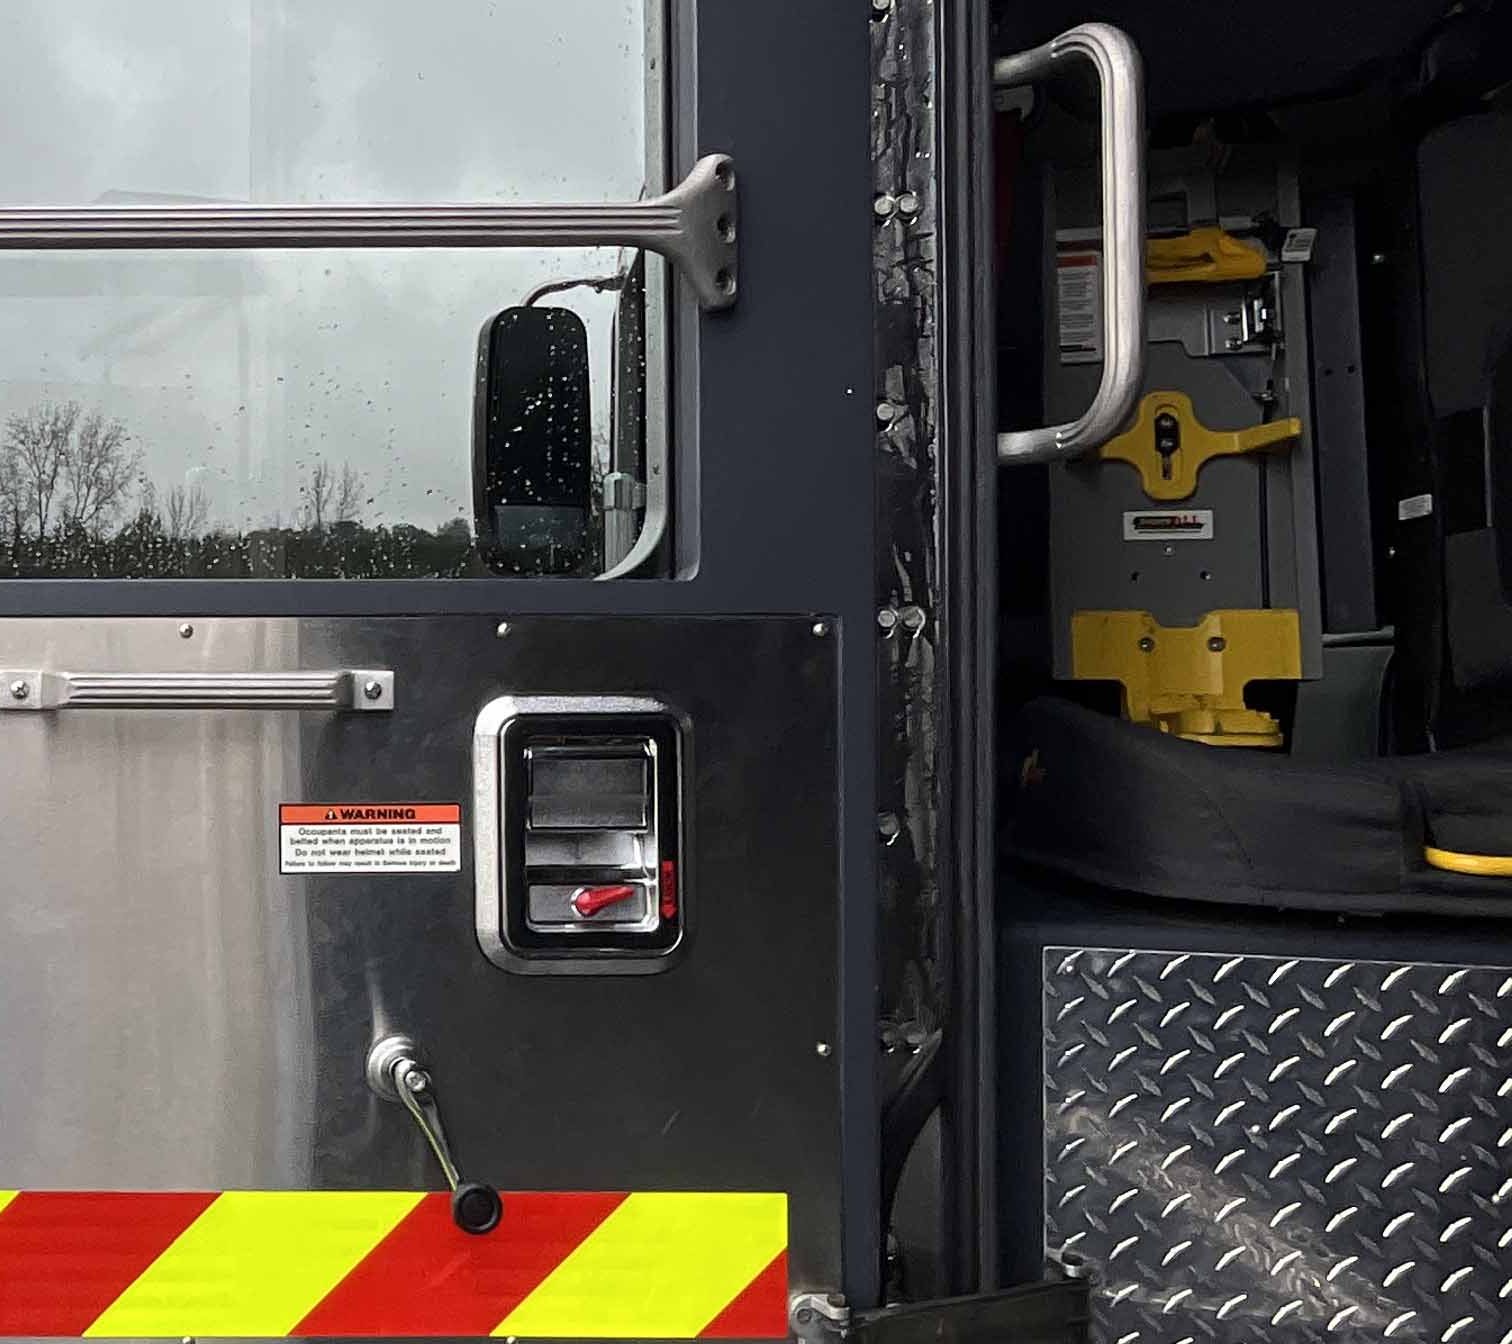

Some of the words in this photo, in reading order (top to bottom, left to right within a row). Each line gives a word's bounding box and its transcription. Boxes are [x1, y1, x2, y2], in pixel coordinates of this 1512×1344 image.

[341, 809, 416, 819] WARNING
[299, 828, 346, 836] Occupants
[426, 827, 442, 835] and
[290, 837, 318, 845] belted
[322, 837, 345, 845] when
[349, 838, 394, 846] apparatus
[355, 848, 385, 856] helmet
[389, 848, 412, 856] while
[415, 848, 446, 856] seated
